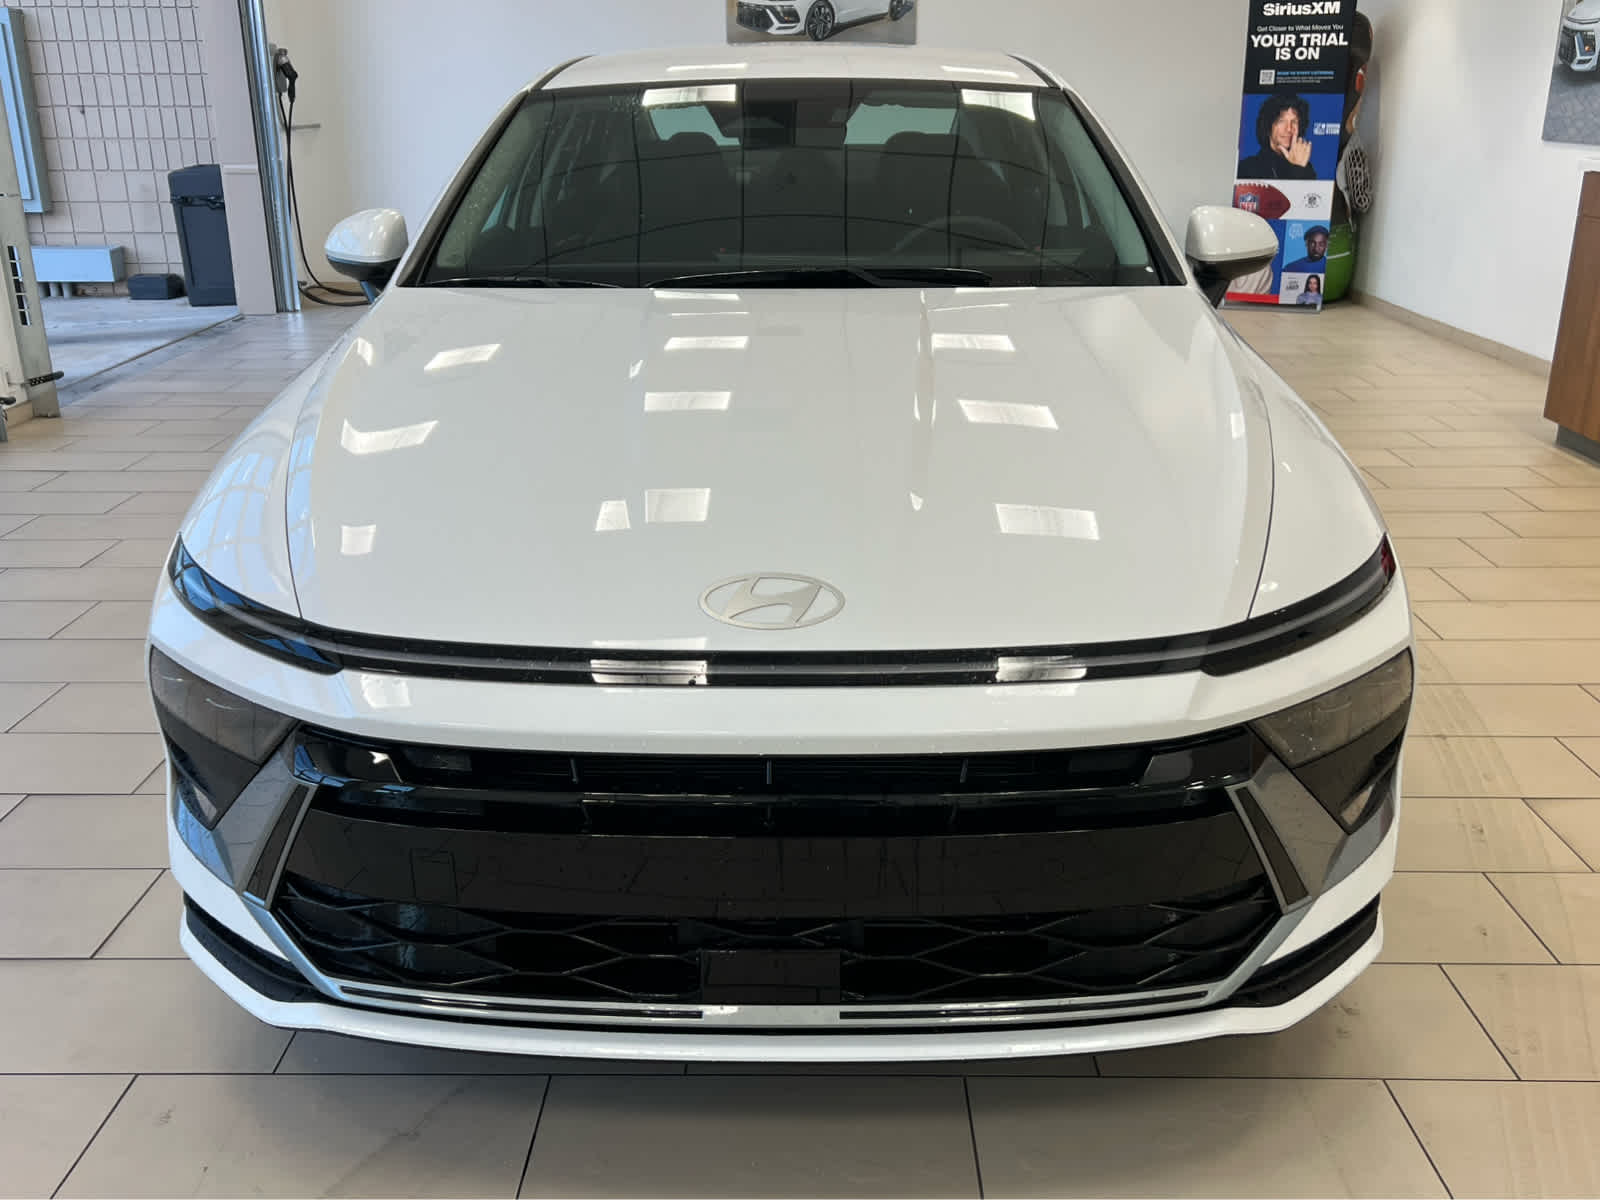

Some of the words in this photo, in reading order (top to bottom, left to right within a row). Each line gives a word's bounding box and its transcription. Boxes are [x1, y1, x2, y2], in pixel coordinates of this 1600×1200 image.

[1263, 1, 1341, 16] SiriusXM
[1250, 34, 1296, 48] YOUR
[1300, 32, 1349, 47] TRIAL
[1275, 47, 1291, 61] IS
[1294, 46, 1320, 60] ON
